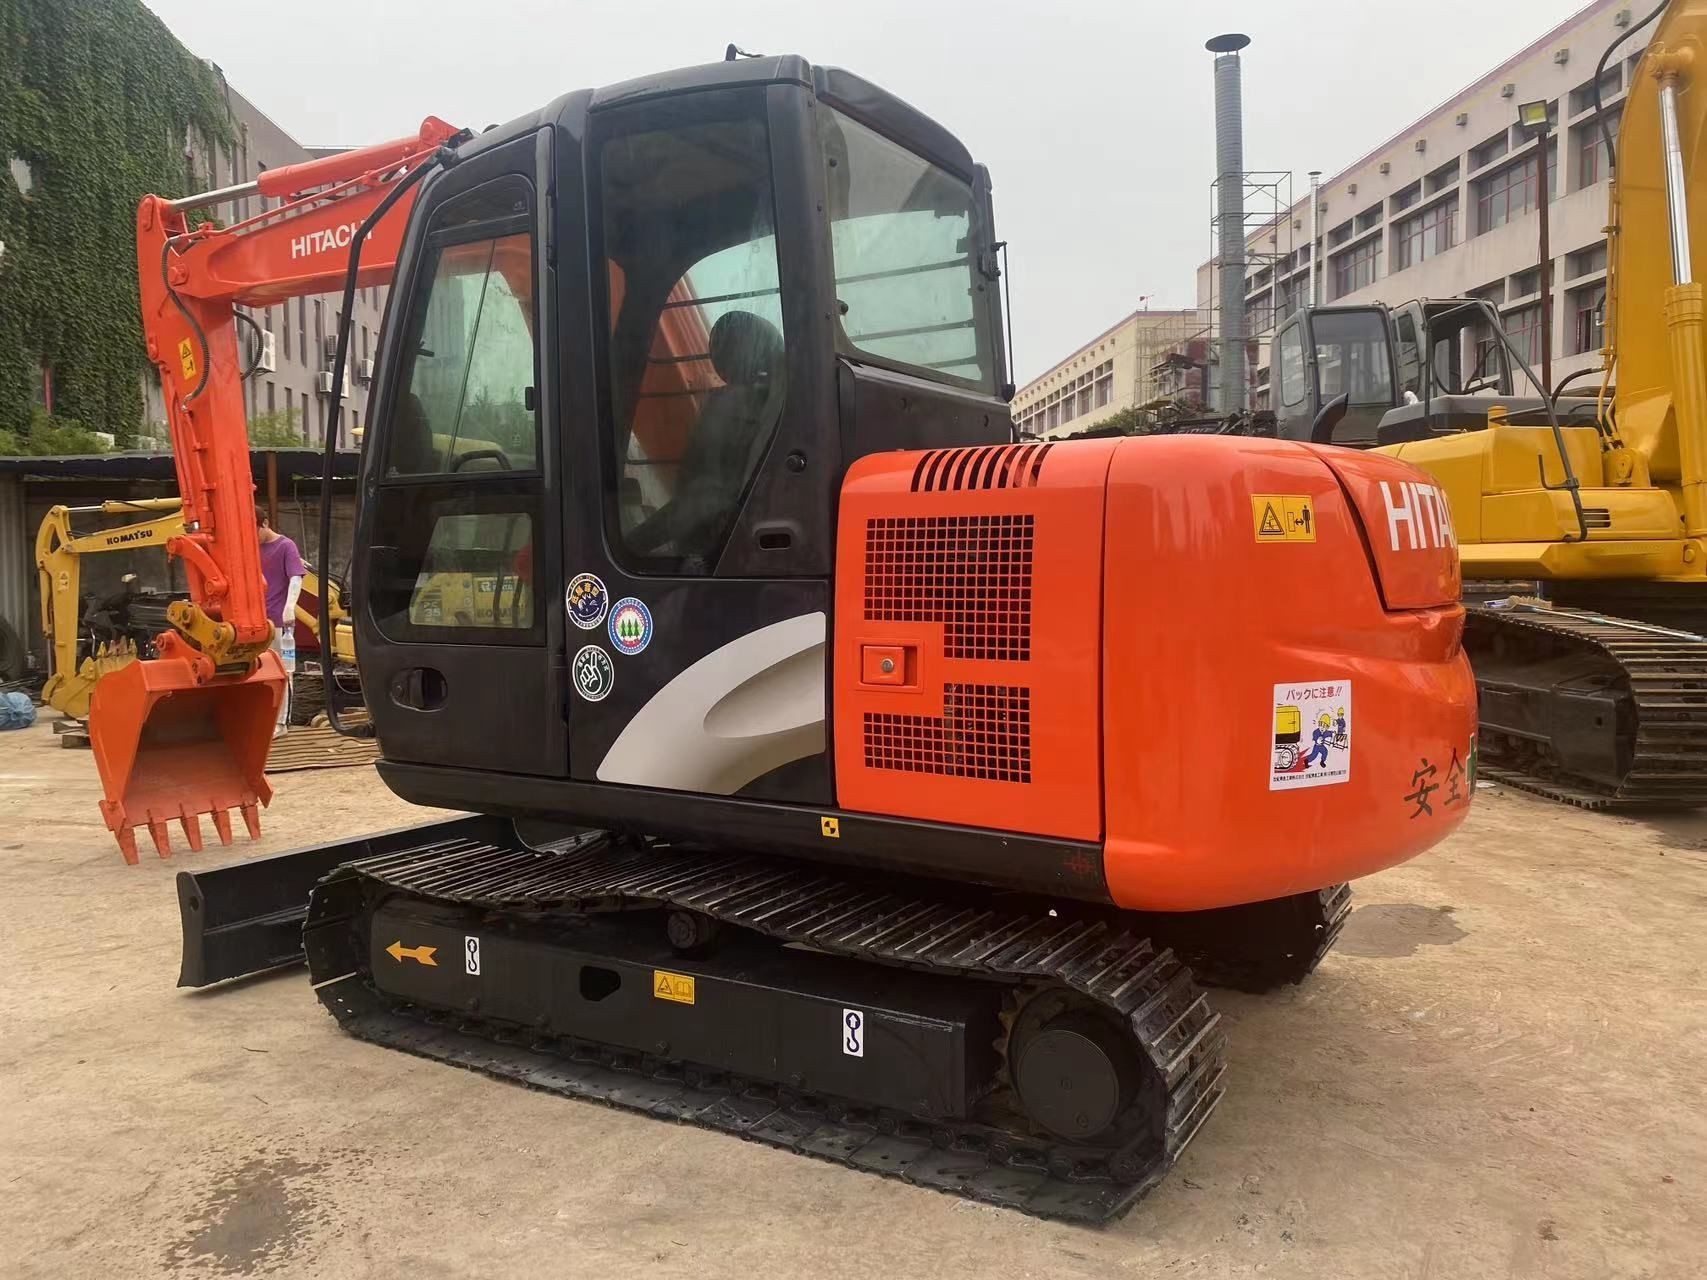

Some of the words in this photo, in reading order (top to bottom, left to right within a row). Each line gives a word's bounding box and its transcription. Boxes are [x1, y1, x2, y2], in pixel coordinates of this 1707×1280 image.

[106, 529, 153, 545] KOMATSU
[1379, 481, 1458, 551] HITA
[1403, 747, 1465, 820] 安全
